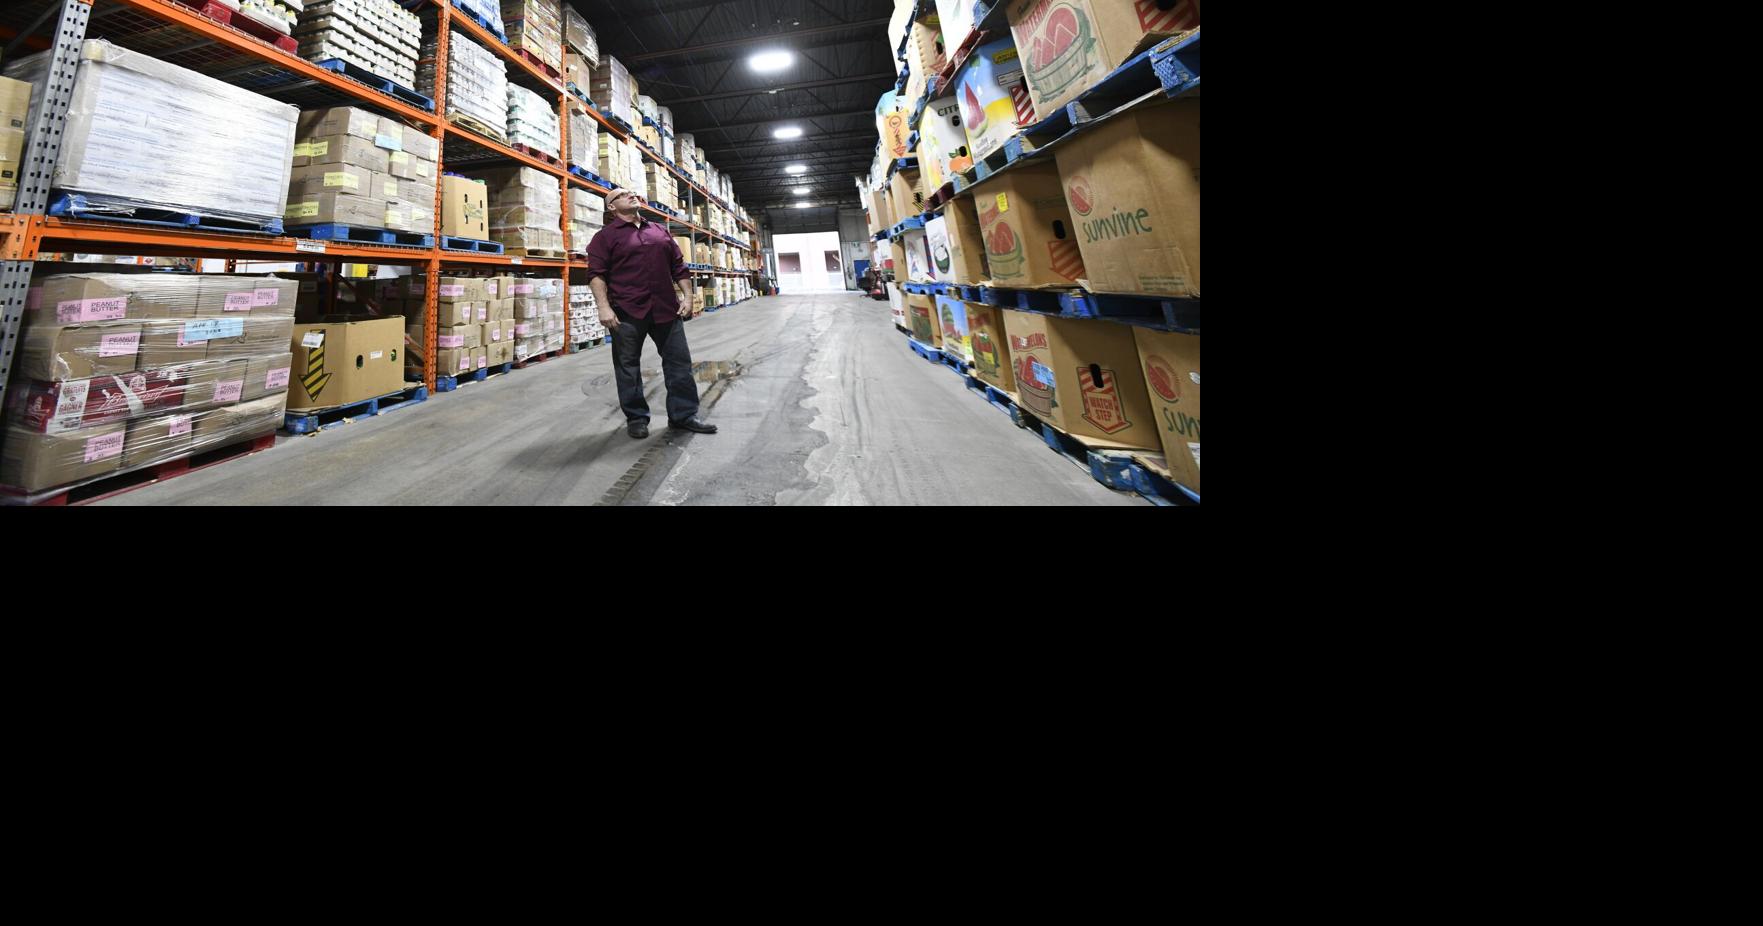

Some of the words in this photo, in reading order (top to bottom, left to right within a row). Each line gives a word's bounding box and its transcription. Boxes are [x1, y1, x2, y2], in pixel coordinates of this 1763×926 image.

[1082, 206, 1153, 243] sunvine
[90, 300, 120, 309] PEANUT
[108, 335, 137, 343] PEANUT
[1089, 396, 1114, 410] WATCH
[1095, 409, 1112, 421] STEP
